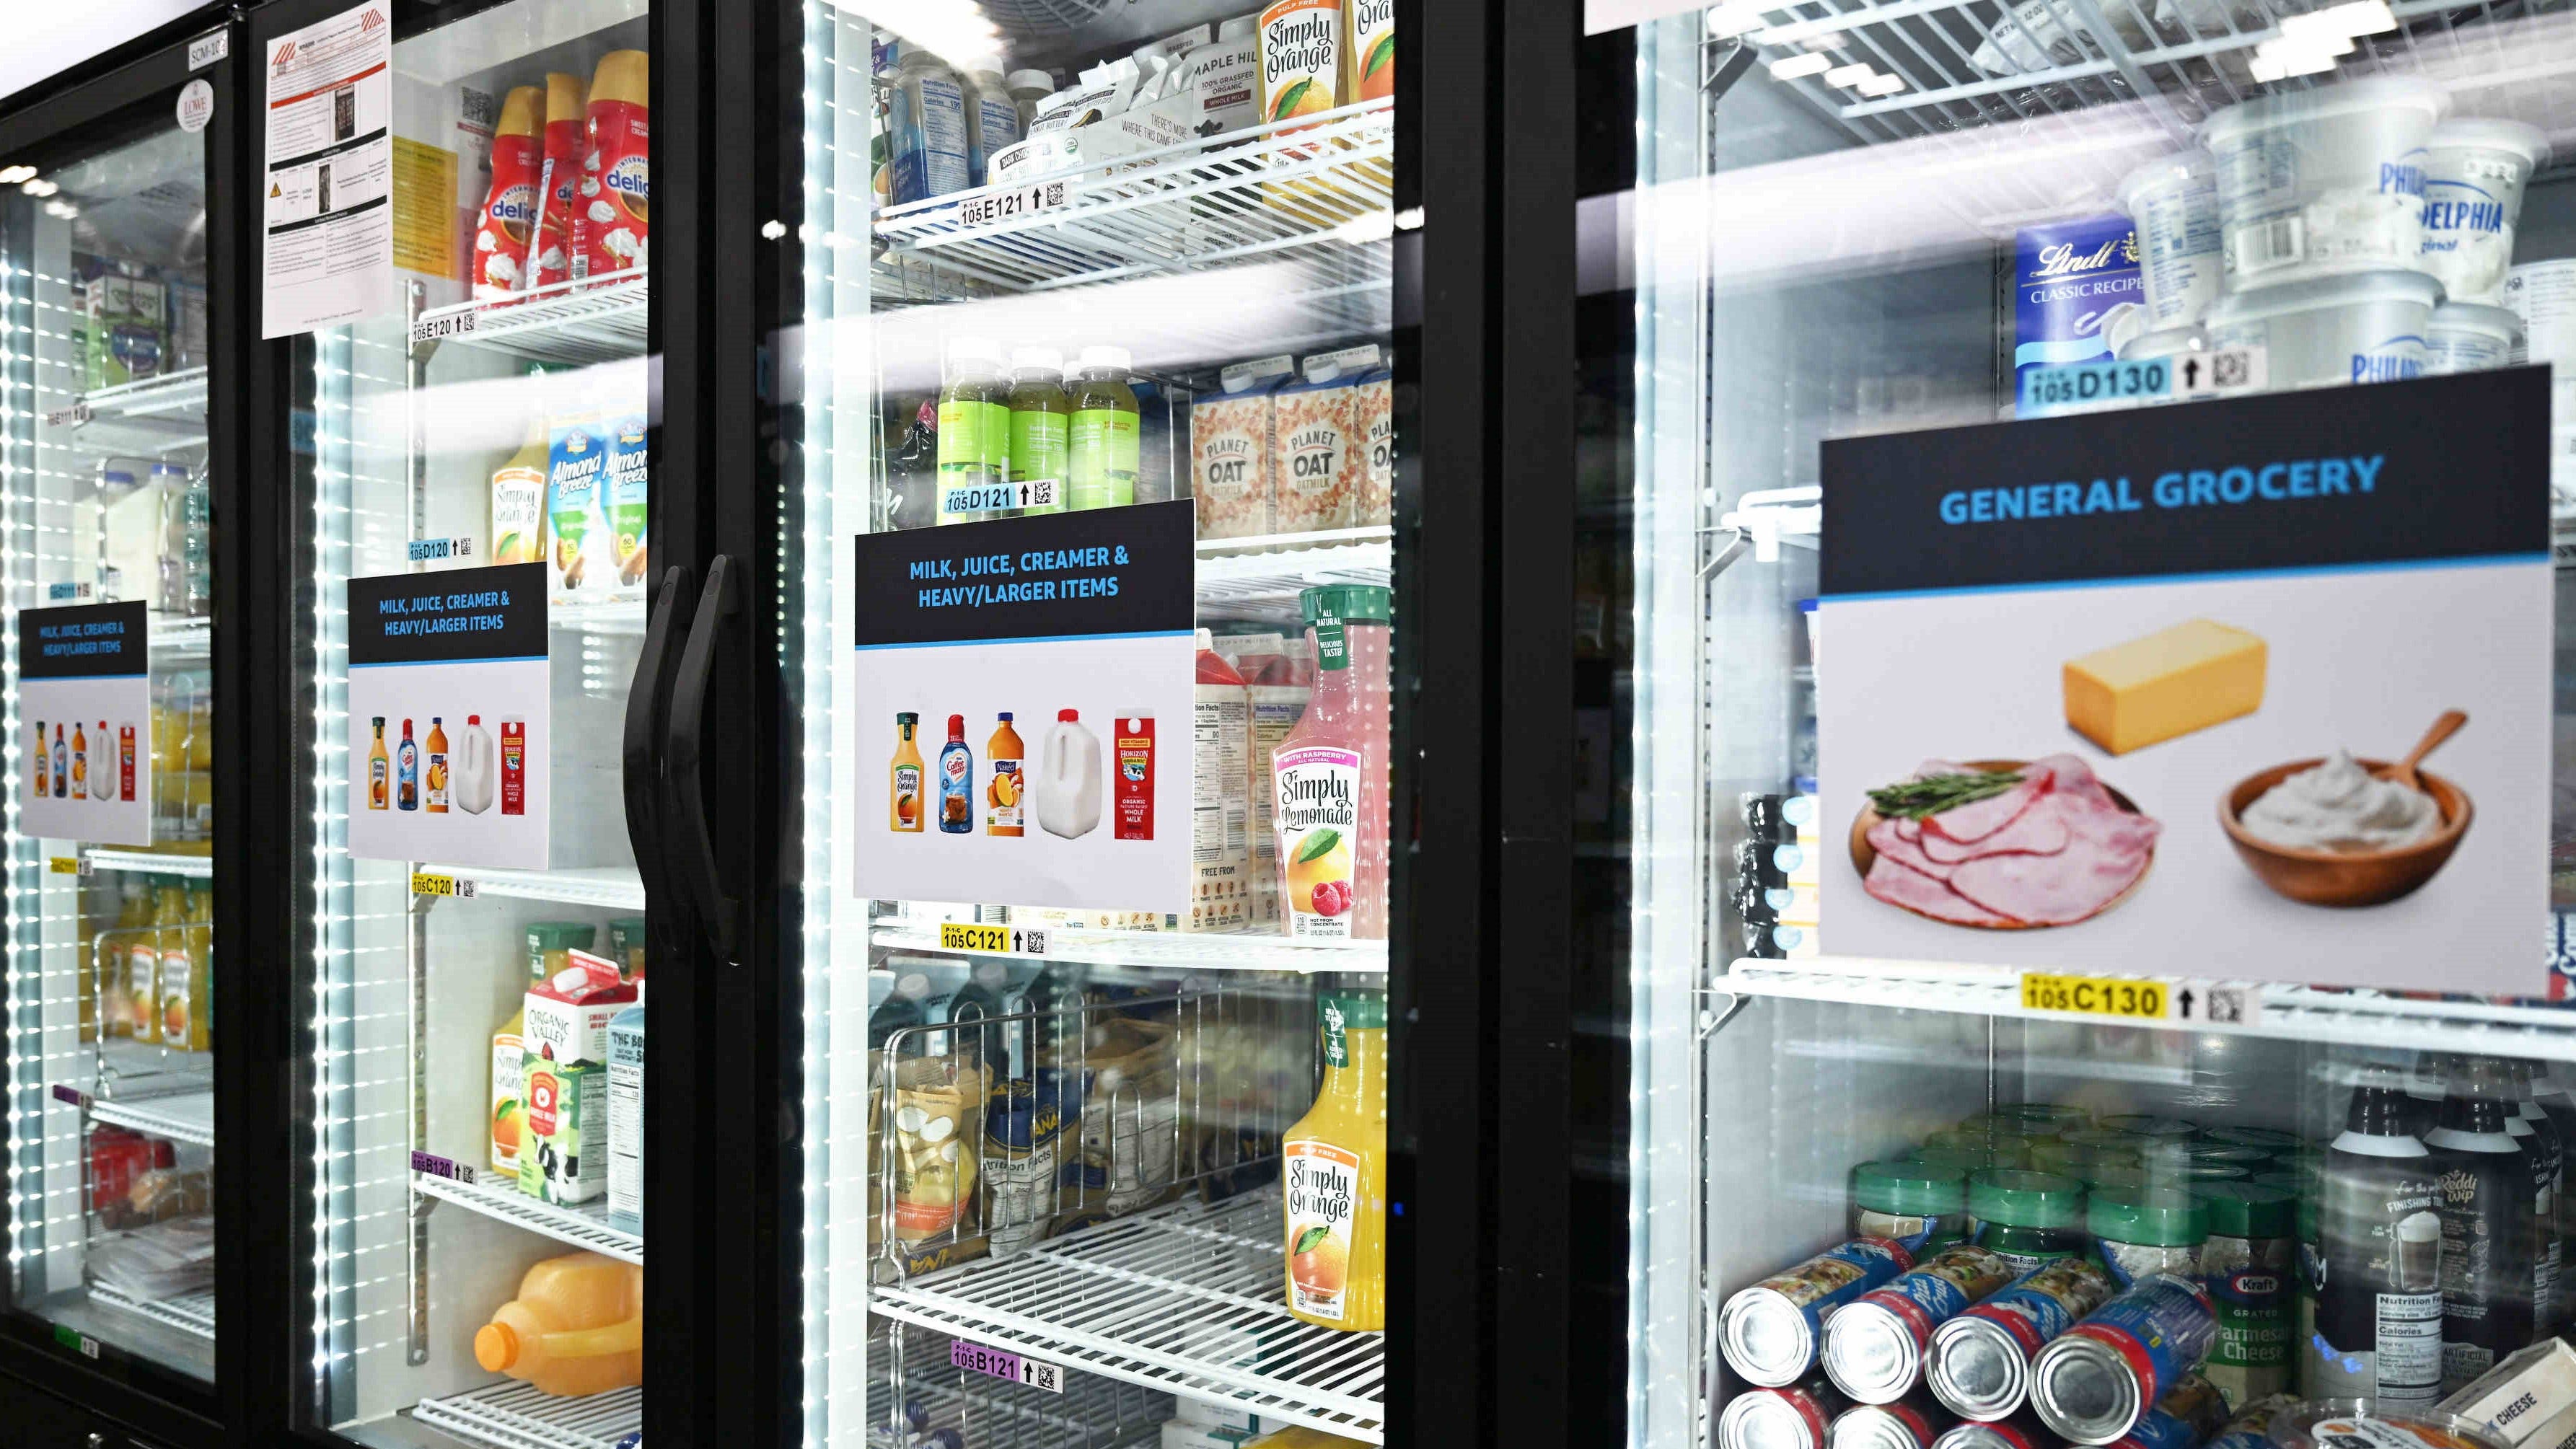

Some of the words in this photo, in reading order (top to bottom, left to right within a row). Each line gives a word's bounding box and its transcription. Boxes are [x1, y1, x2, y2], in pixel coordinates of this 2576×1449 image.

[1267, 13, 1333, 55] Simply
[1267, 45, 1332, 83] Orange
[1202, 79, 1218, 89] 100%
[1219, 71, 1254, 84] GRASSFED
[1212, 82, 1243, 94] ORGANIC
[184, 97, 206, 115] LOWE
[1209, 96, 1229, 106] WHOLE
[1231, 93, 1245, 102] MILK
[1122, 119, 1142, 137] WHERE
[1144, 127, 1156, 142] THIS
[1151, 114, 1172, 131] THERE'S
[1174, 123, 1187, 139] MORE
[1001, 151, 1015, 167] DARK
[962, 193, 1022, 224] 105E121
[2029, 240, 2120, 278] Lindt
[2031, 284, 2091, 304] CLASSIC
[413, 320, 451, 340] 105E120
[2032, 364, 2162, 404] 105D130
[1206, 439, 1249, 459] PLANET
[1291, 431, 1336, 451] PLANET
[550, 451, 602, 487] Almond
[1208, 460, 1247, 484] OAT
[1293, 452, 1334, 477] OAT
[558, 475, 594, 500] Breeze
[1296, 477, 1330, 491] OATMILK
[1938, 476, 2143, 525] GENERAL
[2152, 454, 2385, 508] GROCERY
[947, 487, 1009, 511] 105D121
[411, 542, 448, 560] 105D120
[910, 559, 957, 581] MILK,
[961, 554, 1015, 577] JUICE,
[1020, 546, 1109, 572] CREAMER
[1114, 545, 1130, 565] &
[918, 581, 1055, 608] HEAVY/LARGER
[1061, 576, 1119, 599] ITEMS
[379, 598, 408, 615] MILK,
[411, 596, 444, 613] JUICE,
[447, 591, 498, 610] CREAMER
[501, 590, 510, 606] &
[384, 617, 467, 637] HEAVY/LARGER
[470, 614, 504, 631] ITEMS
[1316, 617, 1342, 627] NATURAL
[1205, 703, 1219, 712] Facts
[1212, 731, 1219, 739] 90
[1120, 749, 1148, 758] HORIZON
[1284, 753, 1301, 762] WITH
[1303, 751, 1347, 759] RASPBERRY
[946, 759, 965, 772] Coffee
[996, 763, 1015, 772] Naked
[1282, 770, 1353, 807] Simply
[1281, 805, 1353, 834] Lemonade
[1201, 867, 1218, 877] FREE
[1219, 866, 1235, 876] FROM
[413, 878, 451, 894] 105C120
[944, 930, 1004, 950] 105C121
[2026, 982, 2160, 1016] 105C130
[528, 1009, 570, 1035] ORGANIC
[531, 1026, 566, 1047] VALLEY
[611, 1031, 630, 1046] THE
[1030, 1114, 1058, 1138] ANA
[413, 1158, 451, 1178] 105B120
[982, 1158, 1024, 1172] utrition
[1291, 1159, 1350, 1201] Simply
[1290, 1189, 1349, 1223] Orange
[2386, 1197, 2432, 1213] FINISHING
[2243, 1279, 2273, 1290] Kraft
[2380, 1297, 2431, 1305] Nutrition
[2220, 1326, 2287, 1342] armesa
[2379, 1326, 2422, 1335] Calories
[956, 1344, 972, 1353] P-1-C
[2223, 1342, 2284, 1361] Cheese
[954, 1351, 1014, 1378] 105B121
[2495, 1391, 2538, 1427] CHEESE
